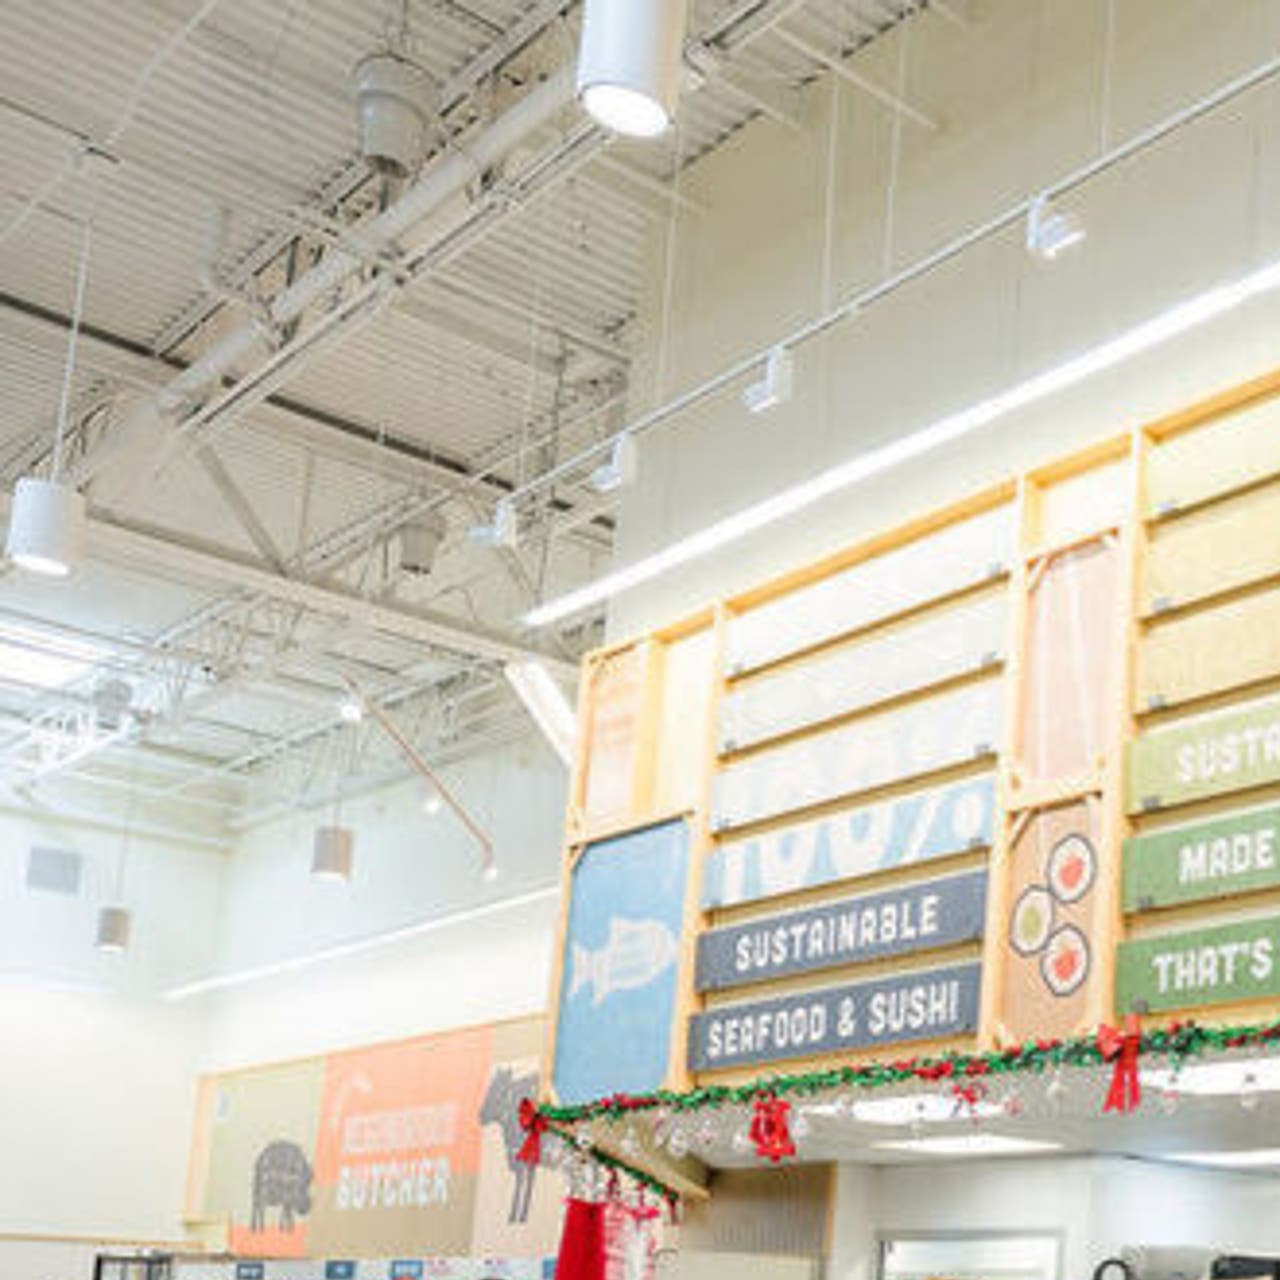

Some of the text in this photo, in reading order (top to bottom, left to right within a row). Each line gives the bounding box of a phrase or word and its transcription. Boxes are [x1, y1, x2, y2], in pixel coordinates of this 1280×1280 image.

[1179, 825, 1274, 883] MADE
[735, 895, 940, 971] SUSTAINABLE
[1152, 935, 1273, 994] THAT'S
[707, 980, 959, 1060] SEAFOOD & SUSHI
[337, 1157, 449, 1210] BUTCHER
